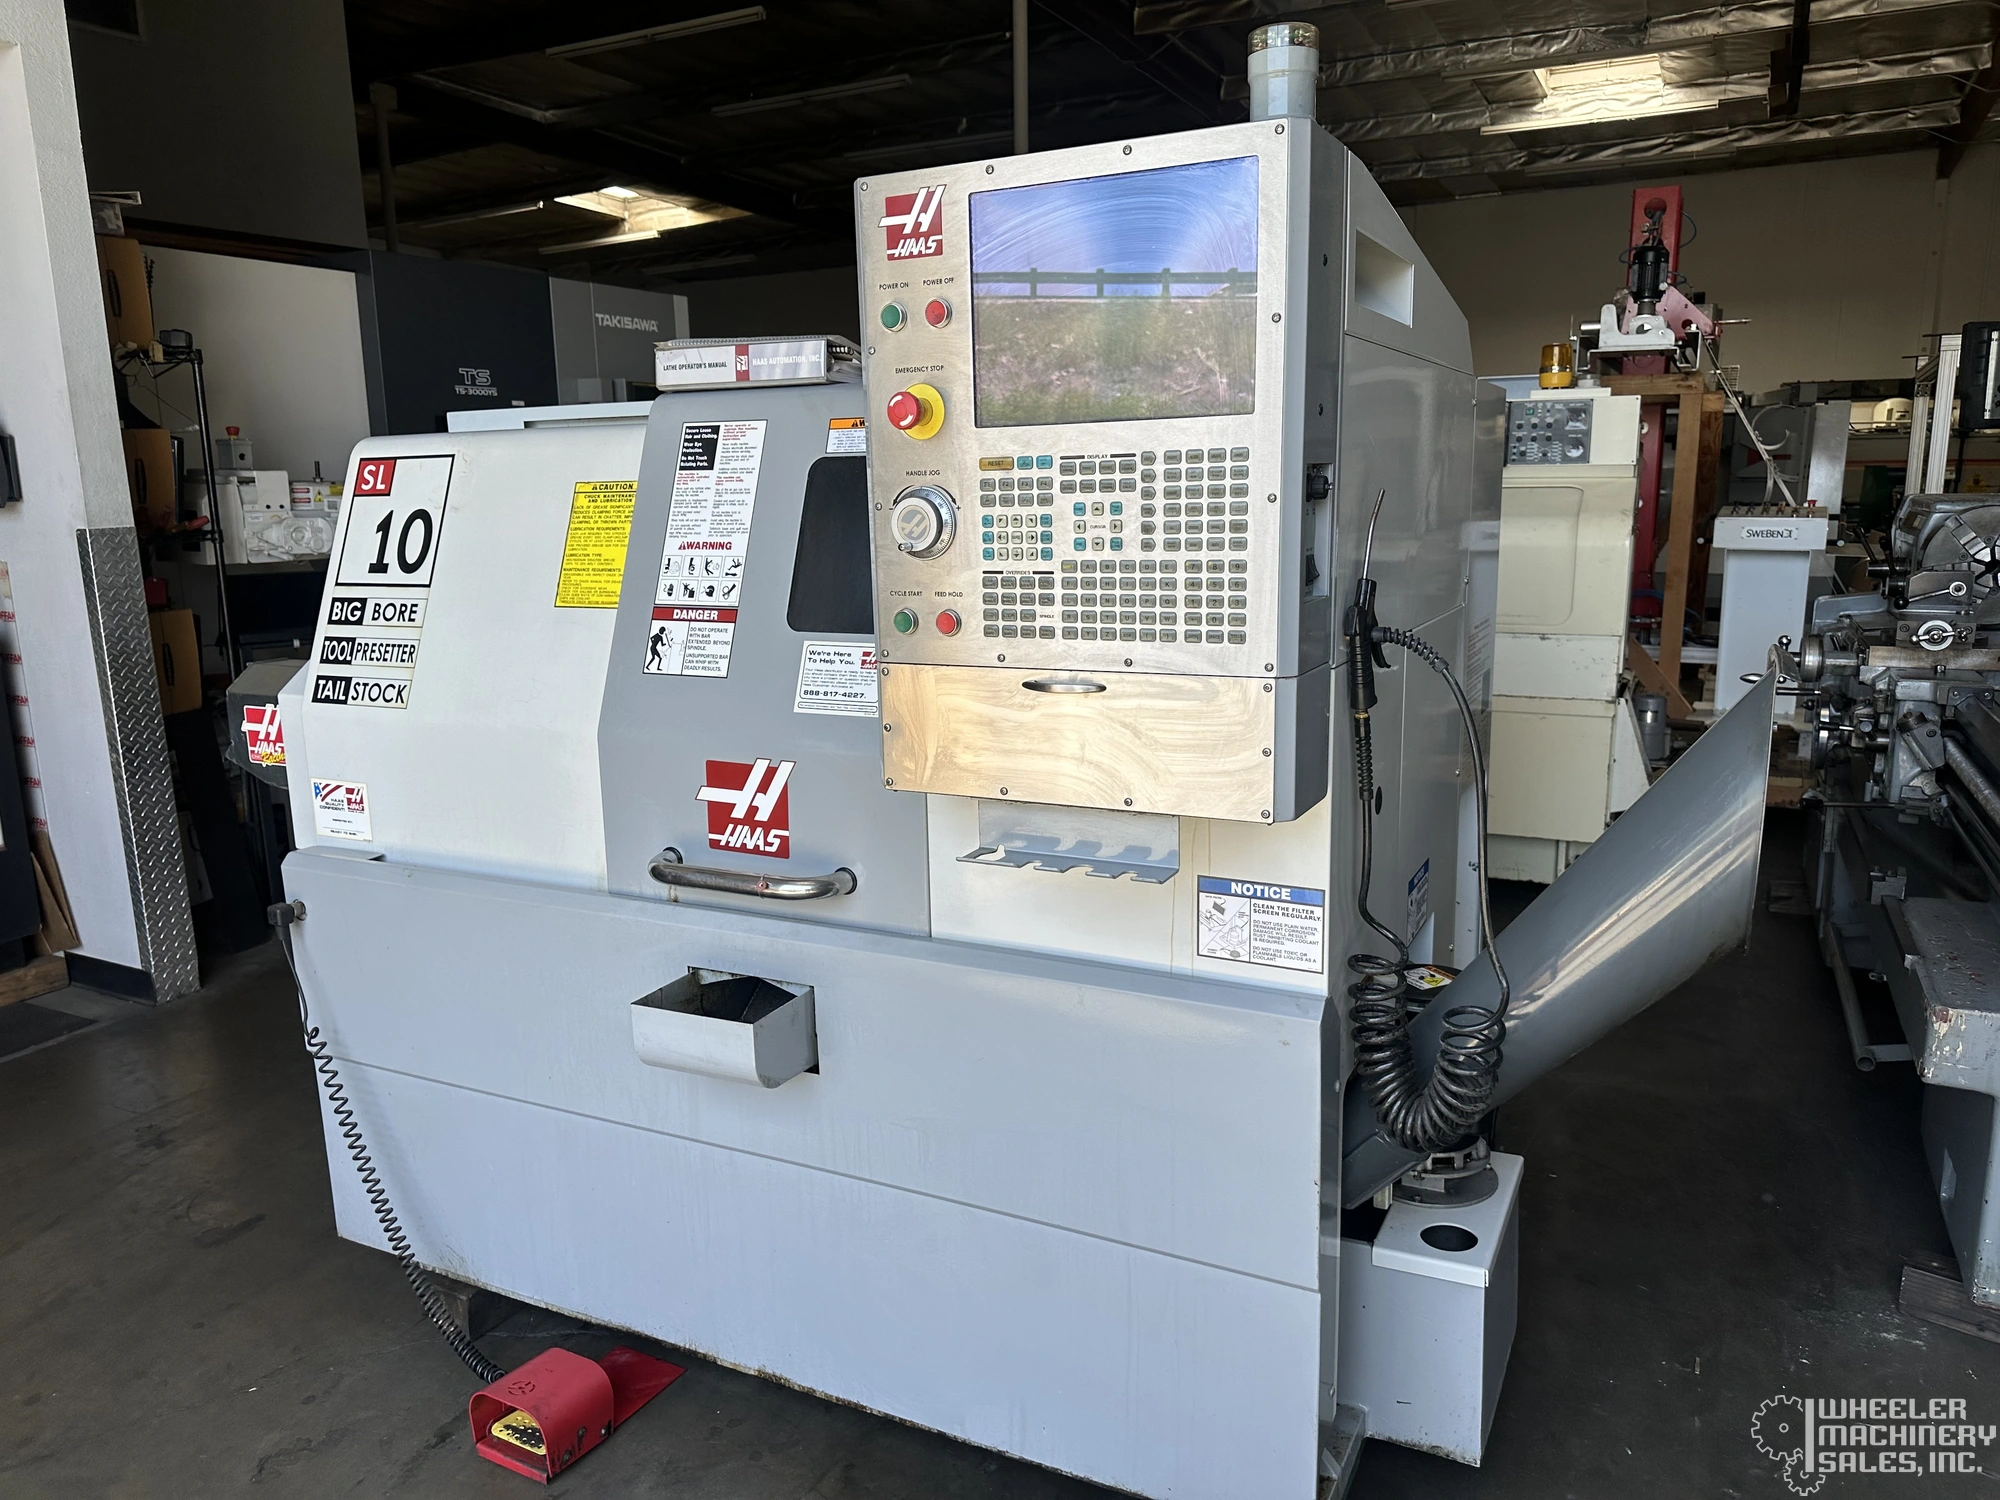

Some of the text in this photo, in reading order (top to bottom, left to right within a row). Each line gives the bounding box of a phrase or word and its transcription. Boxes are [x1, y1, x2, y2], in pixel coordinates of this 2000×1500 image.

[886, 234, 943, 257] HAAS
[878, 281, 909, 291] POWER ON
[922, 278, 943, 286] POWER
[595, 313, 659, 333] TAKISAWA
[769, 356, 807, 364] AUTOMATION,
[458, 367, 492, 386] TS
[895, 365, 929, 374] EMERGENCY
[455, 387, 498, 397] TS-3000YS
[361, 465, 386, 490] SL
[368, 508, 433, 574] 10
[687, 541, 732, 550] WARNING
[331, 601, 419, 622] BIG BORE
[673, 609, 718, 620] DANGER
[322, 640, 416, 664] TOOL PRESETTER
[316, 679, 408, 704] TAIL STOCK
[803, 690, 866, 698] 888-817-4227.
[250, 741, 284, 754] HAAS
[708, 824, 789, 852] HAAS
[1231, 882, 1291, 900] NOTICE
[1282, 912, 1321, 921] REGULARLY.
